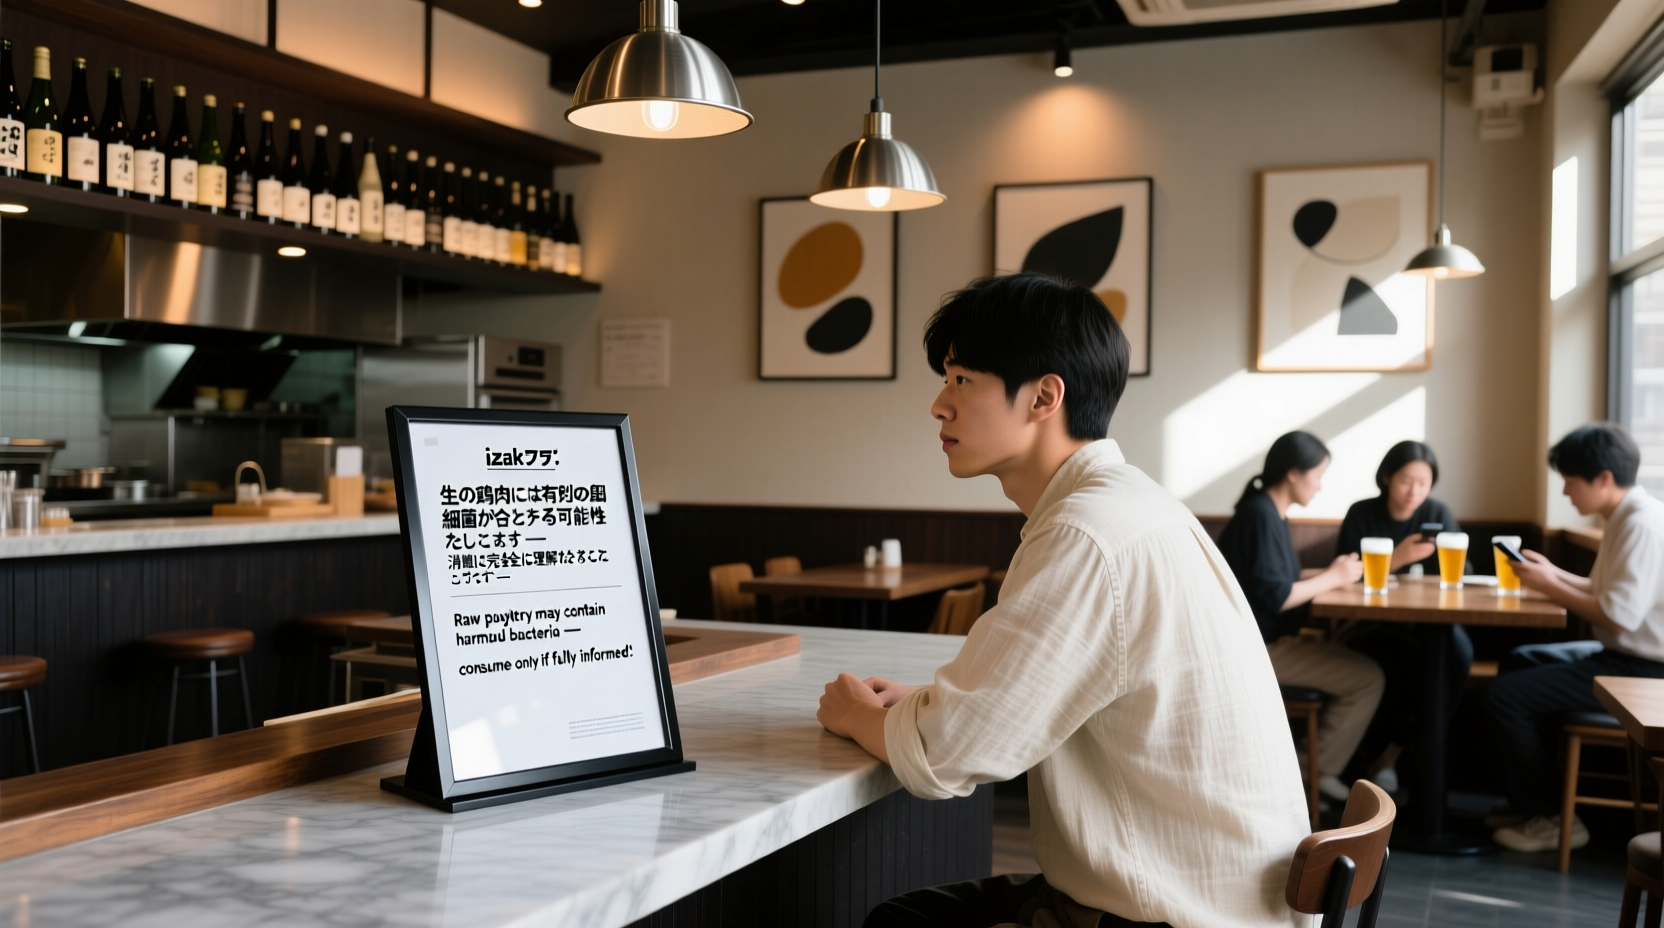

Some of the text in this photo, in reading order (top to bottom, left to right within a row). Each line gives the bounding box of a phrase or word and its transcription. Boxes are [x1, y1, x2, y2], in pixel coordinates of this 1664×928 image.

[454, 613, 481, 627] Raw
[535, 608, 561, 622] may
[563, 602, 606, 618] contain
[514, 655, 539, 671] only
[541, 652, 550, 667] if
